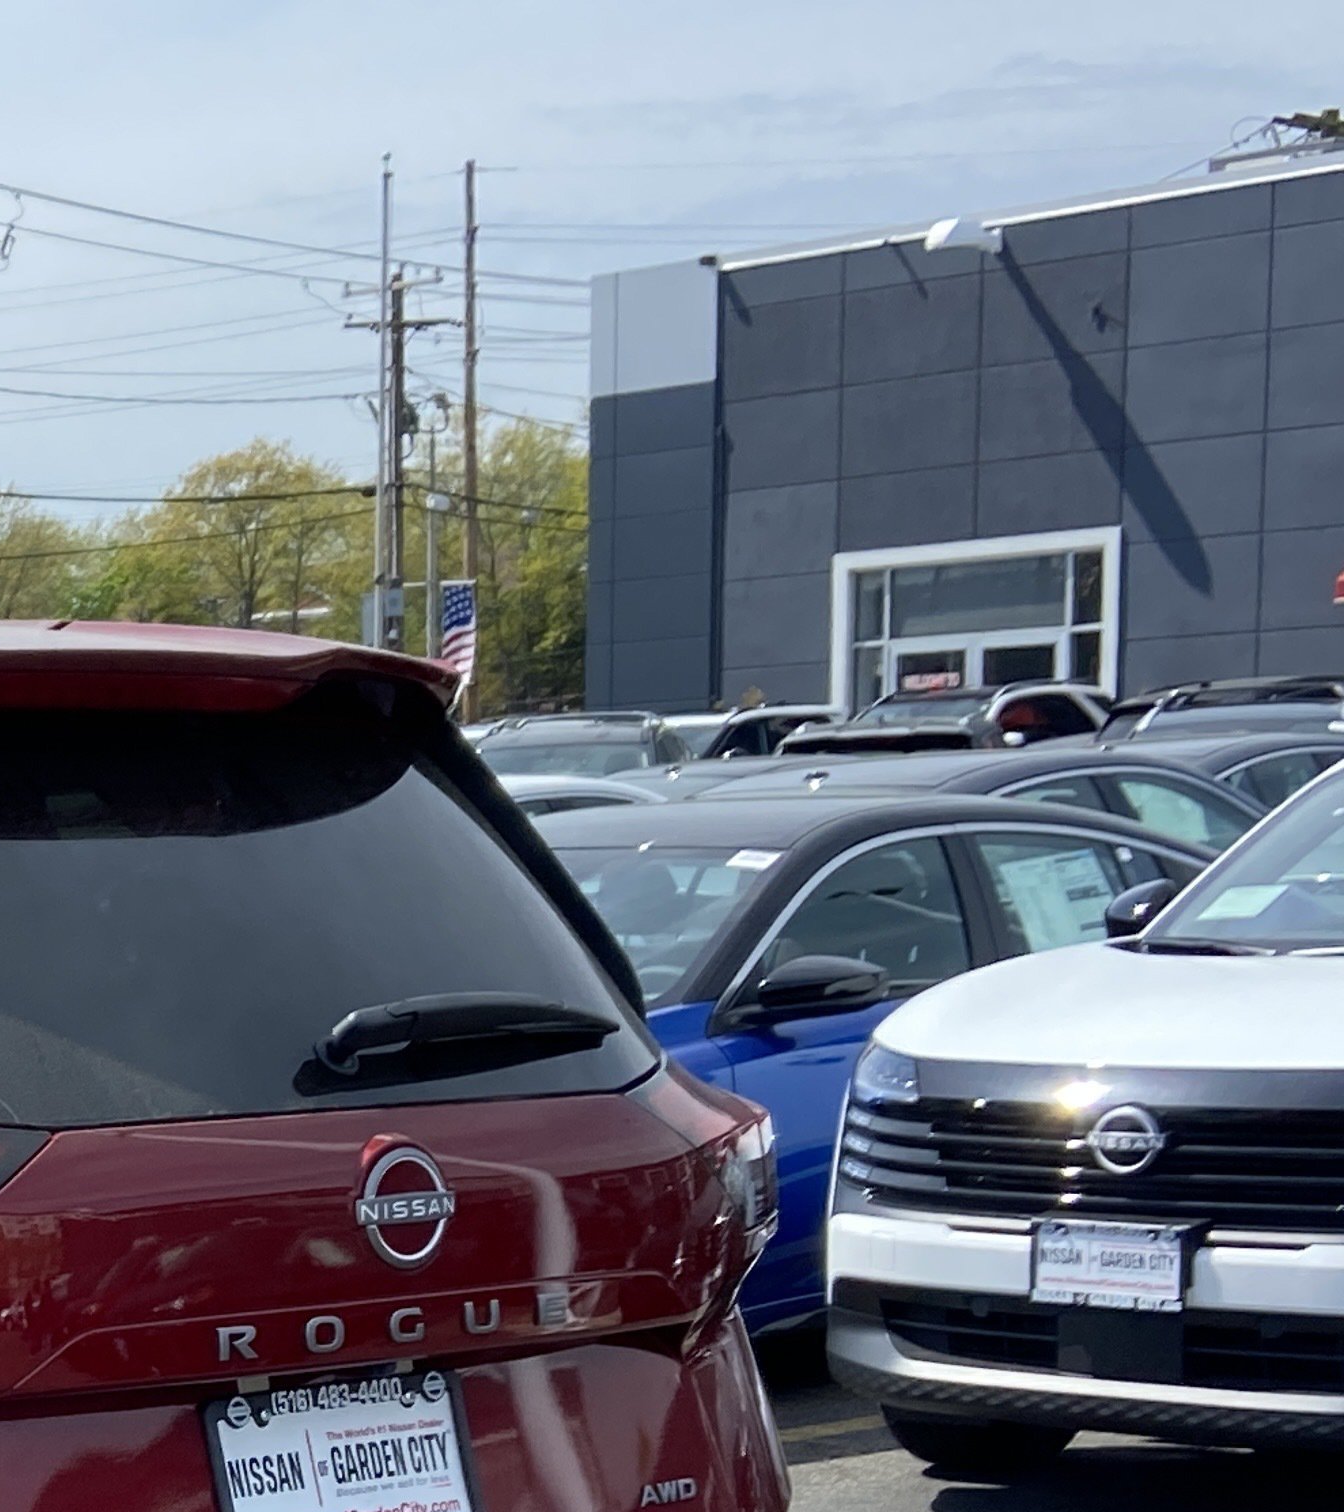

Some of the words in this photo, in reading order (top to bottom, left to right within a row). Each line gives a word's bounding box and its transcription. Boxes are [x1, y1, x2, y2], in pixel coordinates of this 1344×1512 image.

[359, 1194, 456, 1226] NISSAN
[1040, 1248, 1082, 1265] NISSAN
[215, 1293, 569, 1363] ROGUE
[271, 1387, 313, 1415] (516)
[317, 1376, 402, 1410] 483-4400
[226, 1451, 305, 1499] NISSAN
[330, 1437, 408, 1484] GARDEN
[407, 1431, 449, 1474] CITY
[639, 1477, 698, 1510] AWD
